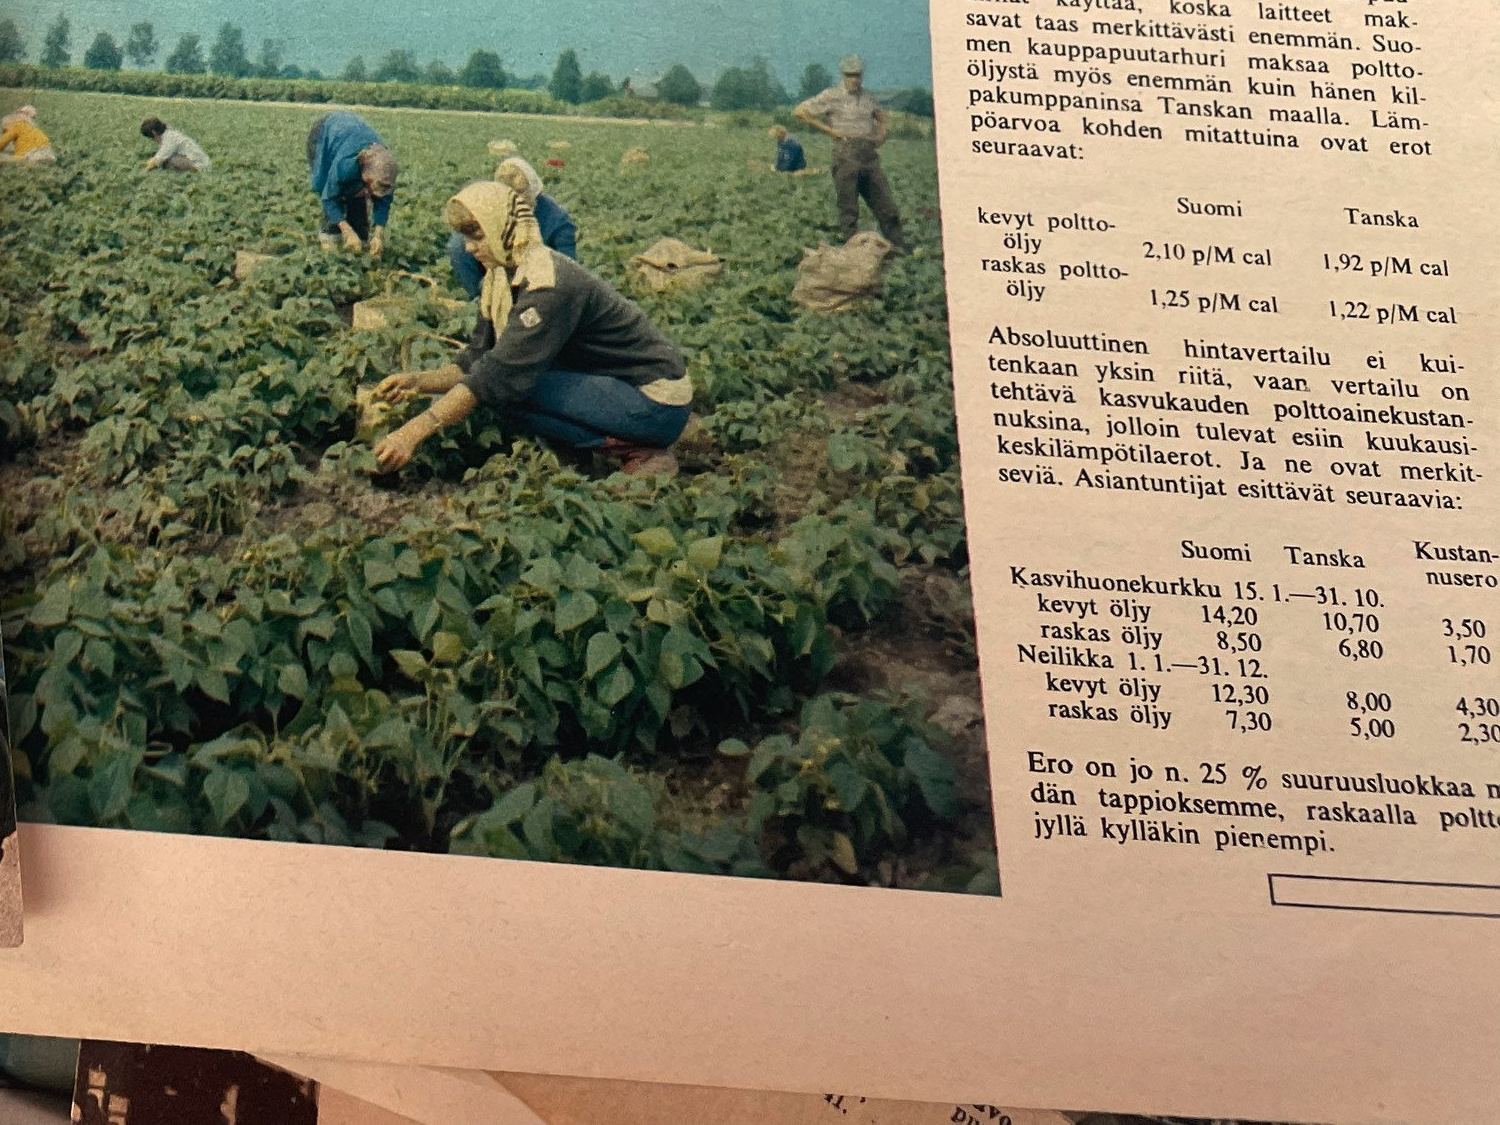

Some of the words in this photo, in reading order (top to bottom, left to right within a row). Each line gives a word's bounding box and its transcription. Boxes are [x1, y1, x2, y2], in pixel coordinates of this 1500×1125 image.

[972, 140, 1083, 159] seuraavat:
[978, 207, 1035, 230] kevyt
[1047, 213, 1115, 232] poltto-
[1177, 197, 1242, 217] Suomi
[1344, 208, 1419, 228] Tanska
[1004, 233, 1042, 254] öljy
[1143, 242, 1185, 261] 2,10
[1192, 245, 1235, 266] p/M
[1243, 249, 1272, 266] cal
[1324, 254, 1363, 273] 1,92
[1370, 256, 1413, 277] p/M
[1420, 260, 1448, 276] cal
[981, 256, 1046, 274] raskas
[1059, 261, 1129, 280] poltto-
[1006, 280, 1046, 302] öljy
[1151, 289, 1190, 309] 1,25
[1197, 293, 1241, 313] p/M
[1249, 296, 1279, 313] cal
[1330, 301, 1370, 320] 1,22
[1376, 303, 1420, 324] p/M
[1427, 307, 1457, 324] cal
[988, 326, 1150, 354] Absoluuttinen
[1183, 339, 1330, 365] hintavertailu
[1367, 350, 1386, 370] ei
[1419, 353, 1464, 373] kui-
[1181, 540, 1252, 562] Suomi
[1283, 546, 1366, 568] Tanska
[1412, 540, 1499, 563] Kustan-
[1009, 566, 1222, 603] Kasvihuonekurkku
[1425, 572, 1498, 588] nusero
[1037, 593, 1099, 619] kevyt
[1110, 599, 1151, 623] öljy
[1201, 605, 1257, 628] 14,20
[1323, 612, 1379, 635] 10,70
[1442, 618, 1486, 641] 3,50
[1017, 644, 1114, 669] Neilikka
[1040, 621, 1111, 642] raskas
[1121, 626, 1162, 650] öljy
[1217, 631, 1262, 654] 8,50
[1339, 638, 1383, 661] 6,80
[1447, 645, 1491, 667] 1,70
[1045, 671, 1108, 699] kevyt
[1119, 678, 1161, 703] öljy
[1211, 683, 1269, 707] 12,30
[1346, 691, 1391, 714] 8,00
[1048, 700, 1118, 721] raskas
[1130, 704, 1172, 730] öljy
[1226, 710, 1272, 733] 7,30
[1350, 717, 1395, 740] 5,00
[1027, 751, 1073, 774] Ero
[1085, 761, 1117, 778] on
[1130, 757, 1153, 784] jo
[1164, 767, 1190, 783] n.
[1199, 763, 1227, 785] 25
[1242, 765, 1267, 791] %
[1282, 773, 1476, 798] suuruusluokkaa
[1030, 781, 1077, 806] dän
[1097, 788, 1284, 826] tappioksemme,
[1306, 801, 1417, 825] raskaalla
[1035, 811, 1088, 839] jyllä
[1100, 817, 1200, 845] kylläkin
[1214, 825, 1335, 857] pienempi.
